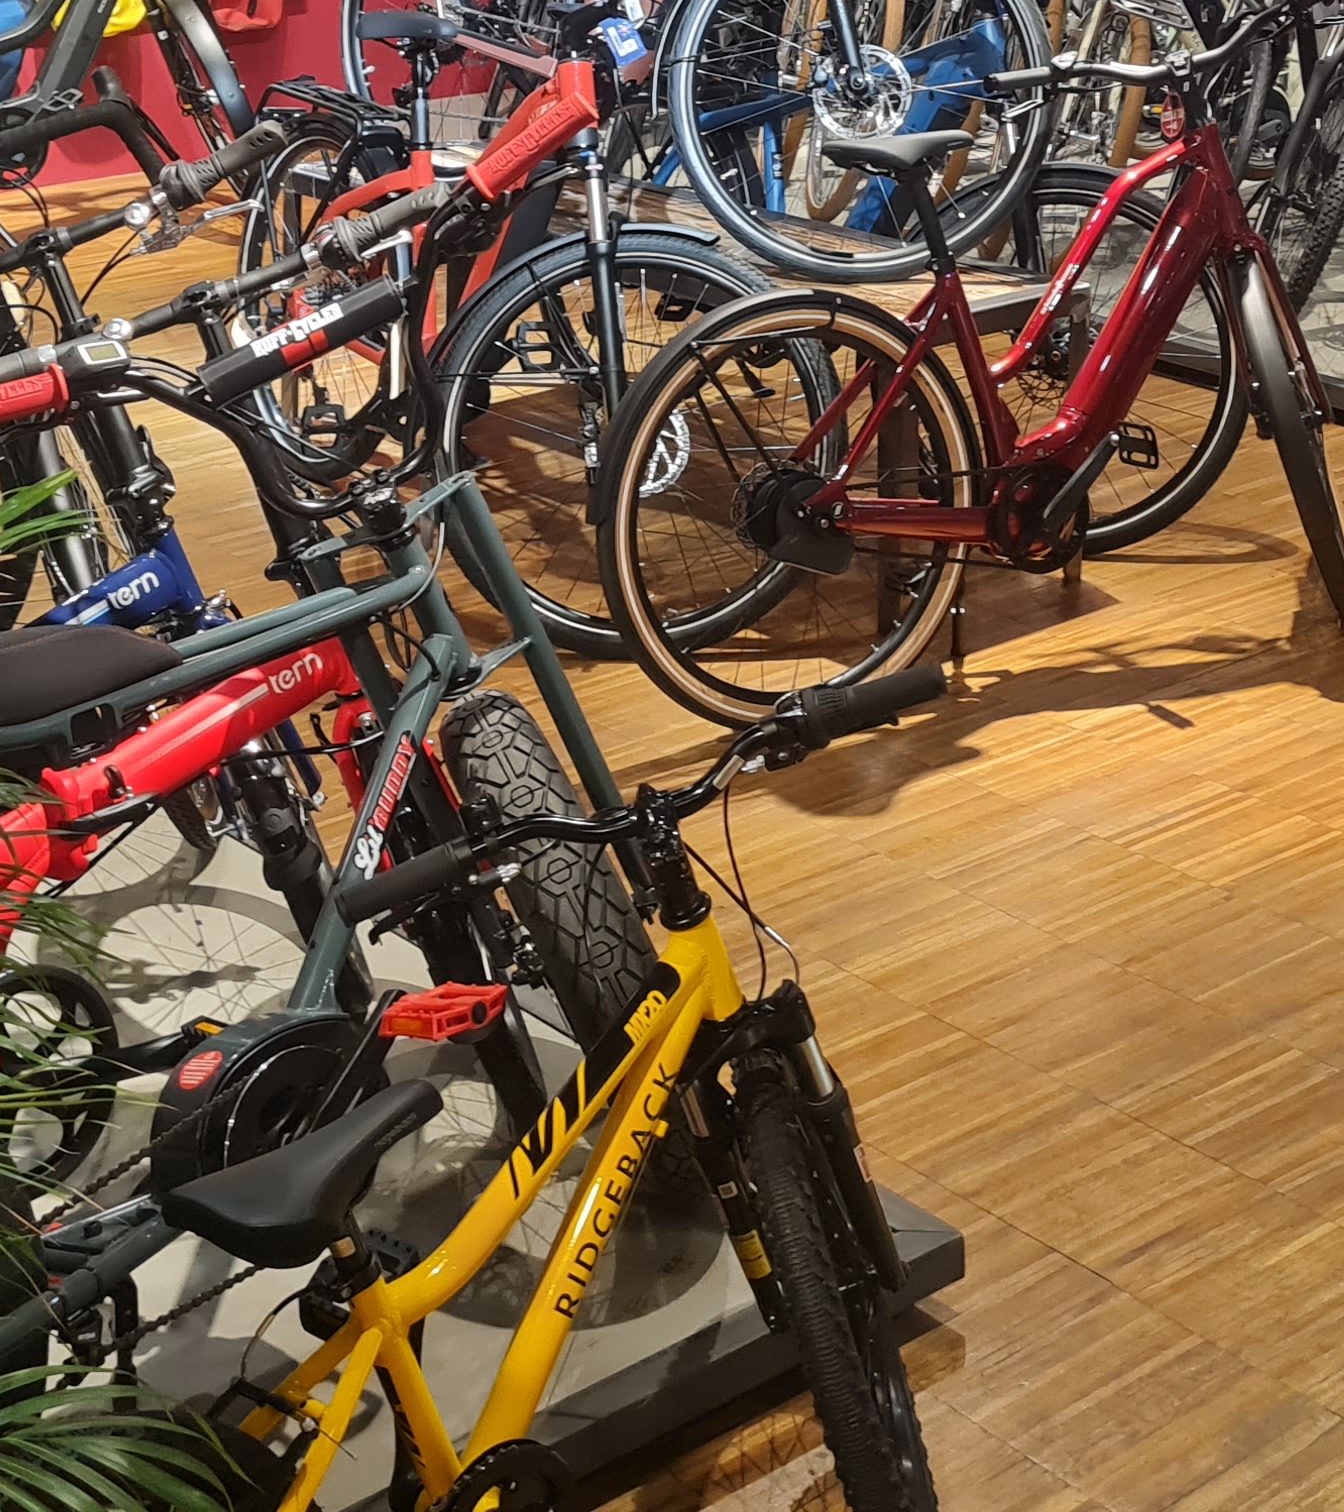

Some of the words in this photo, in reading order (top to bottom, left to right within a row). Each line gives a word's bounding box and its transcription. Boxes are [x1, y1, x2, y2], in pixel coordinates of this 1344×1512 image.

[106, 571, 160, 610] tern
[268, 652, 323, 694] tern
[553, 1060, 679, 1320] RIDGEBACK
